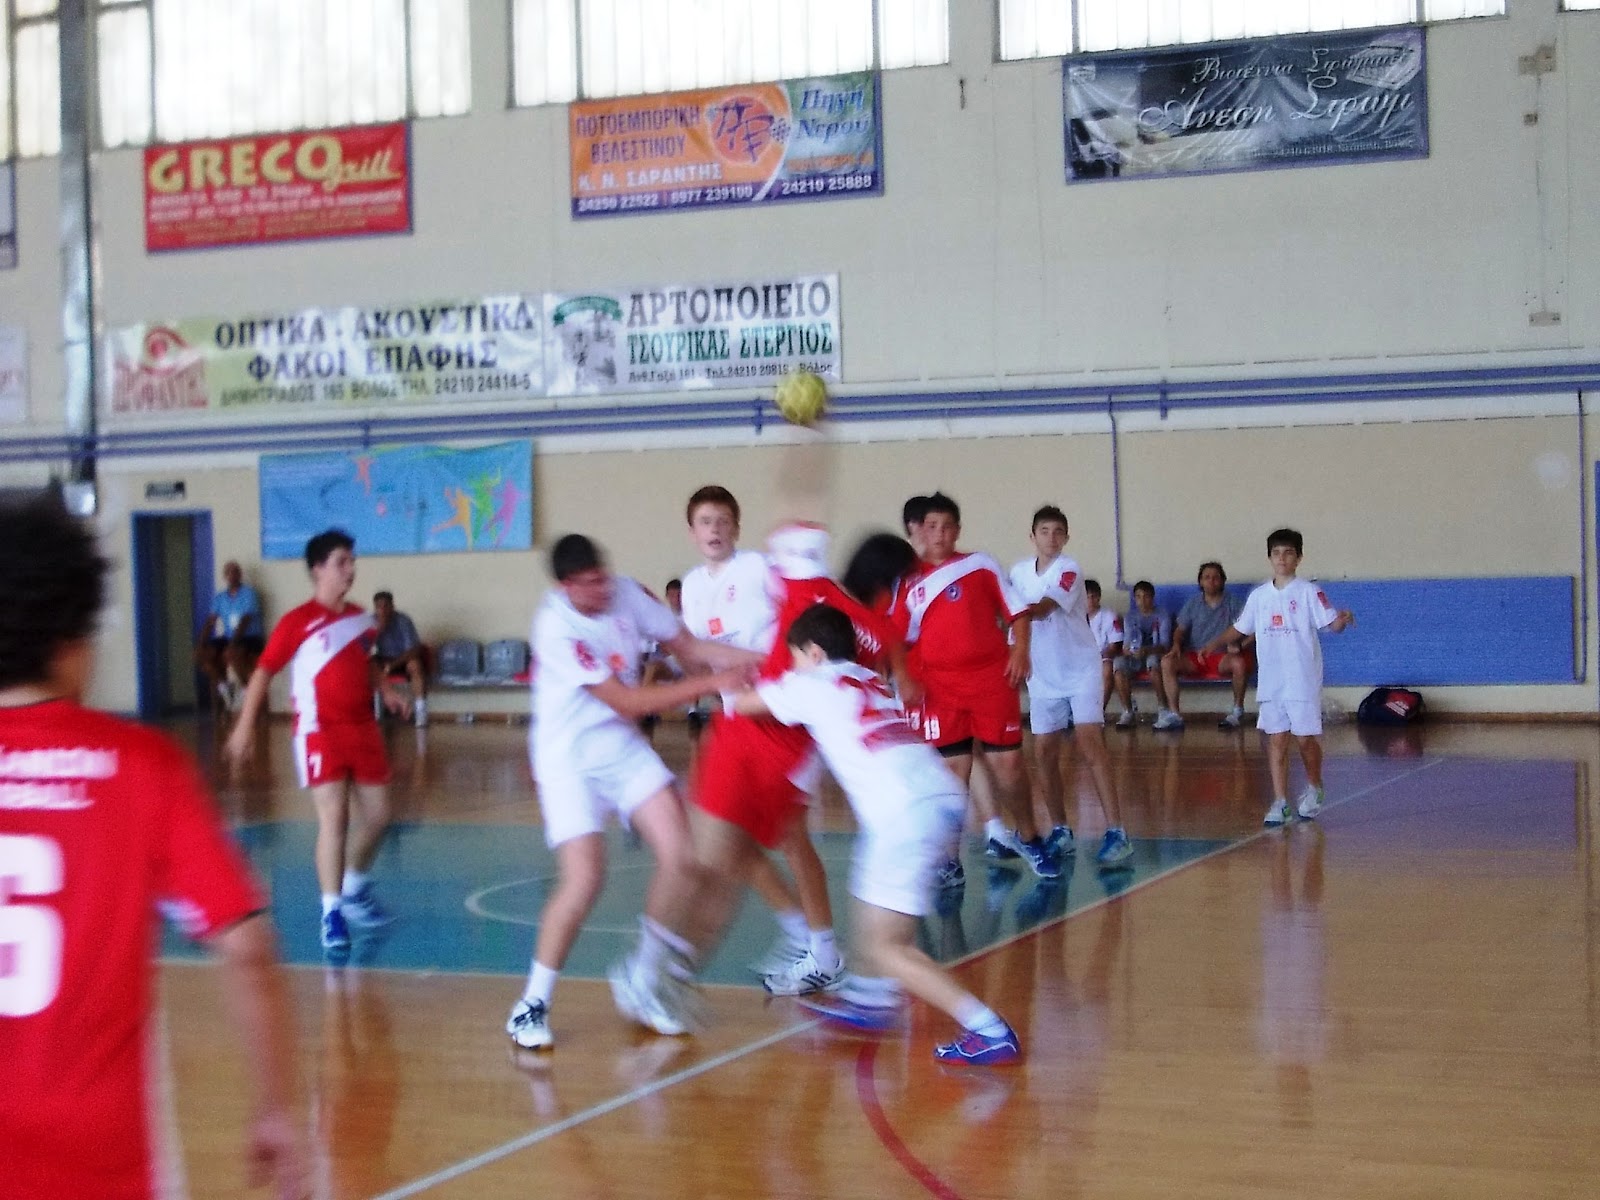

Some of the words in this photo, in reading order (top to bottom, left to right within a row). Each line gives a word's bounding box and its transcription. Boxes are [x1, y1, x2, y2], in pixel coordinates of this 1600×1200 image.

[150, 135, 343, 192] GRECO
[591, 134, 686, 165] ΒΕΛΕΣΤΙΝΟΥ
[626, 163, 722, 187] ΣΑΡΑΝΤΗΣ
[782, 180, 824, 195] 24210
[214, 317, 326, 349] ΟΠΤΙΚΑ
[353, 300, 534, 342] ΑΚΟΥΣΤΙΚΑ
[628, 281, 832, 327] ΑΡΤΟΠΟΙΕΙΟ
[247, 347, 347, 382] ΦΑΚΟΙ
[365, 340, 498, 375] ΕΠΑΦΗΣ
[628, 328, 731, 365] ΤΣΟΥΡΙΚΑΣ
[740, 322, 833, 359] ΣΤΕΡΓΙΟΣ
